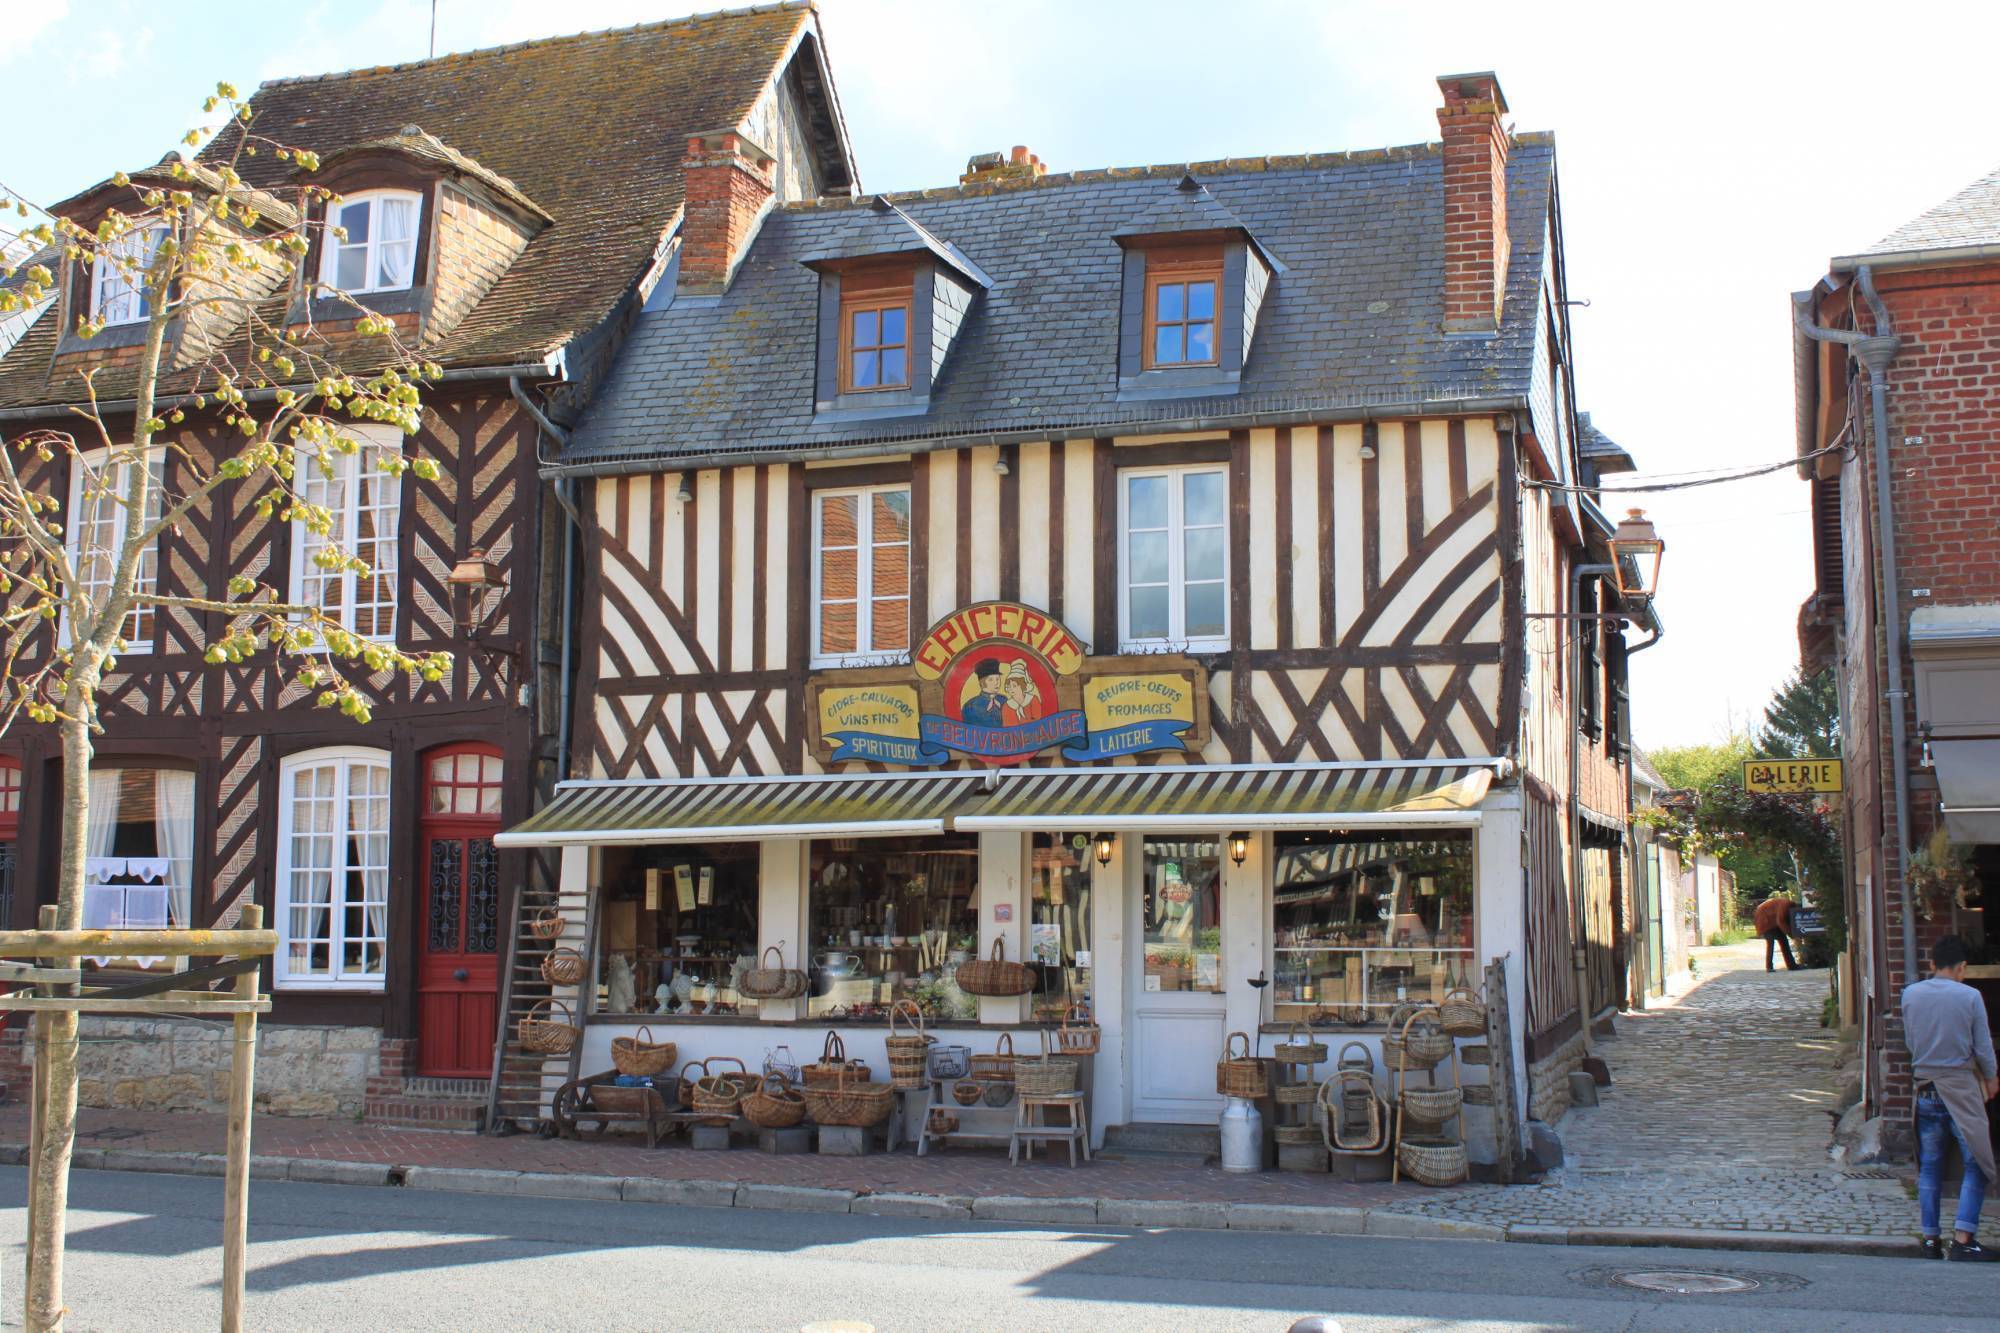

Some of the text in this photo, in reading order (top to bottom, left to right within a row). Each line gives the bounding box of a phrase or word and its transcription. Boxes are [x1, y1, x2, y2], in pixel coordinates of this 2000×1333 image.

[916, 605, 1080, 673] EPICERIE
[1107, 703, 1172, 717] FROMAGES
[942, 721, 1025, 752] BEUVRON
[1038, 713, 1082, 744] AUGE
[1100, 727, 1153, 753] LAITERIE
[852, 737, 918, 760] SPIRITUEUX
